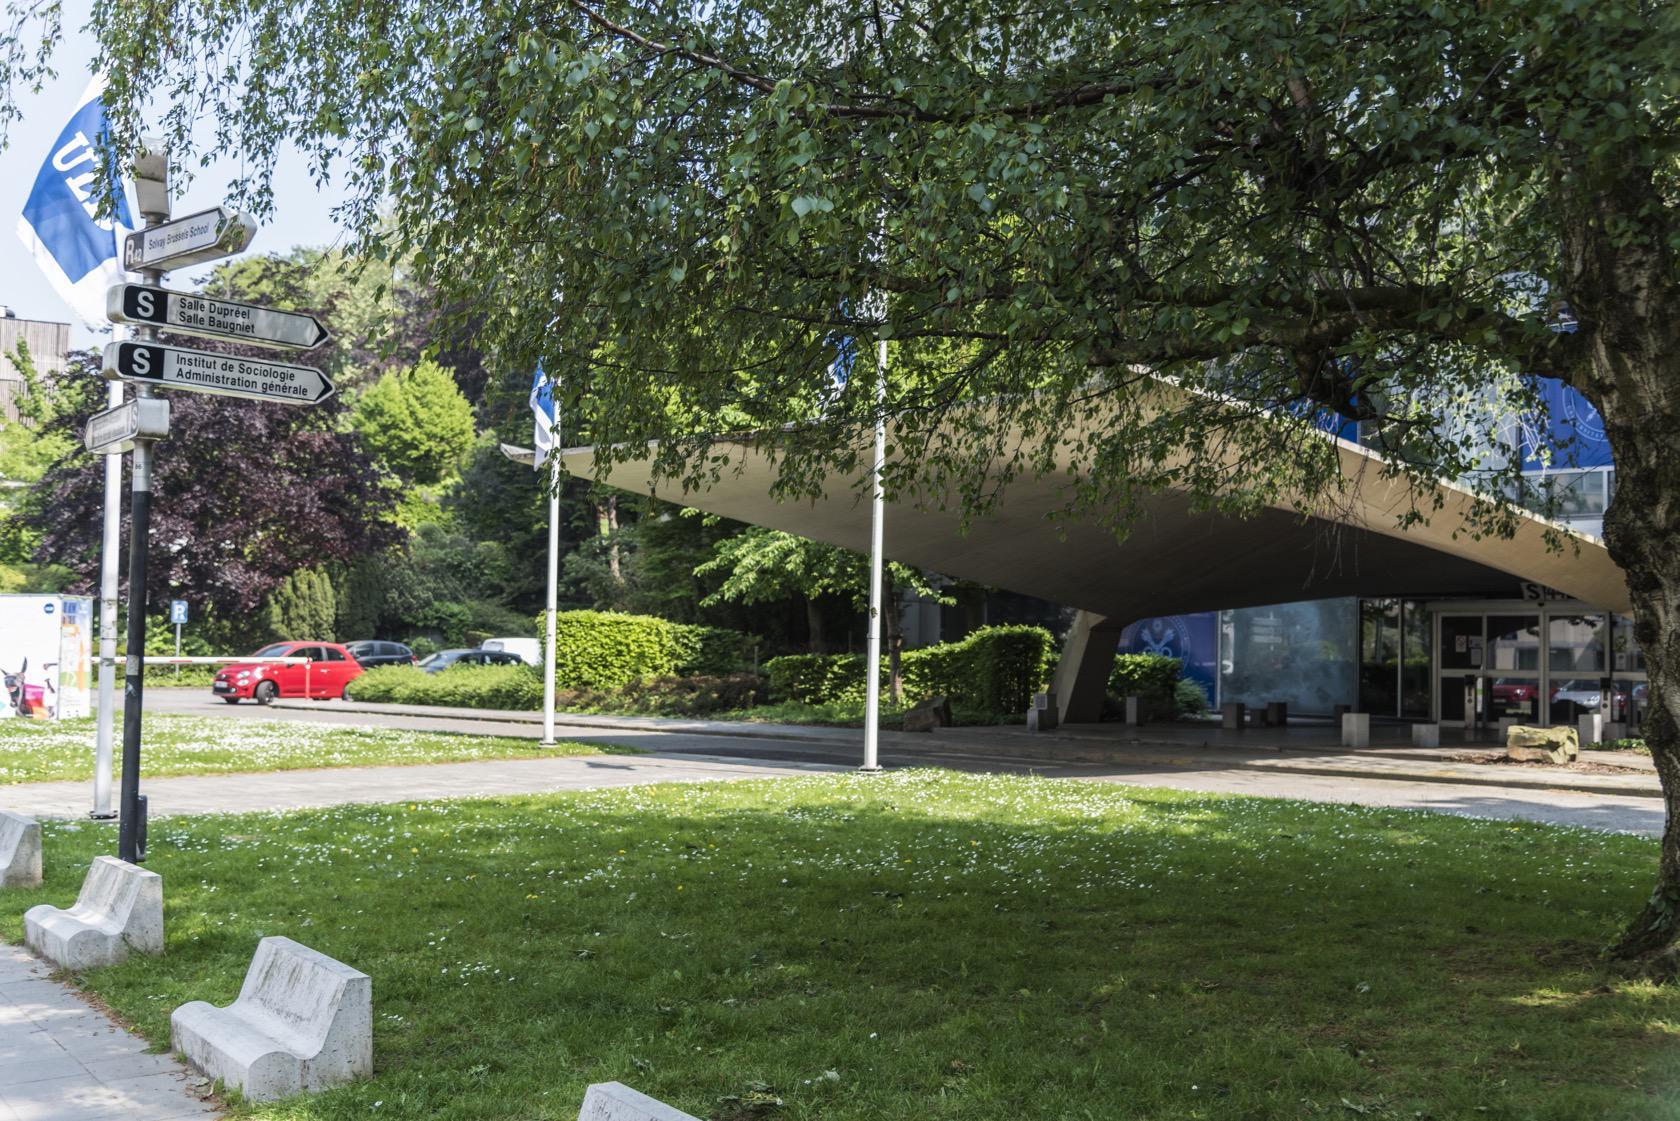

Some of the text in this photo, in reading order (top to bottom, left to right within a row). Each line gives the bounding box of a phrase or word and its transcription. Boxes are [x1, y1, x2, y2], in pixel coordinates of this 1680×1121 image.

[149, 238, 165, 250] Solvay
[167, 229, 188, 245] Brussels
[190, 222, 209, 238] School
[137, 291, 154, 317] S
[179, 298, 250, 319] Salle Dupréel
[179, 312, 255, 334] Salle Baugniet
[132, 348, 150, 374] S
[176, 354, 295, 381] Institut de Sociologie
[176, 368, 308, 396] Administration générale
[132, 405, 138, 430] S
[1526, 583, 1540, 599] S
